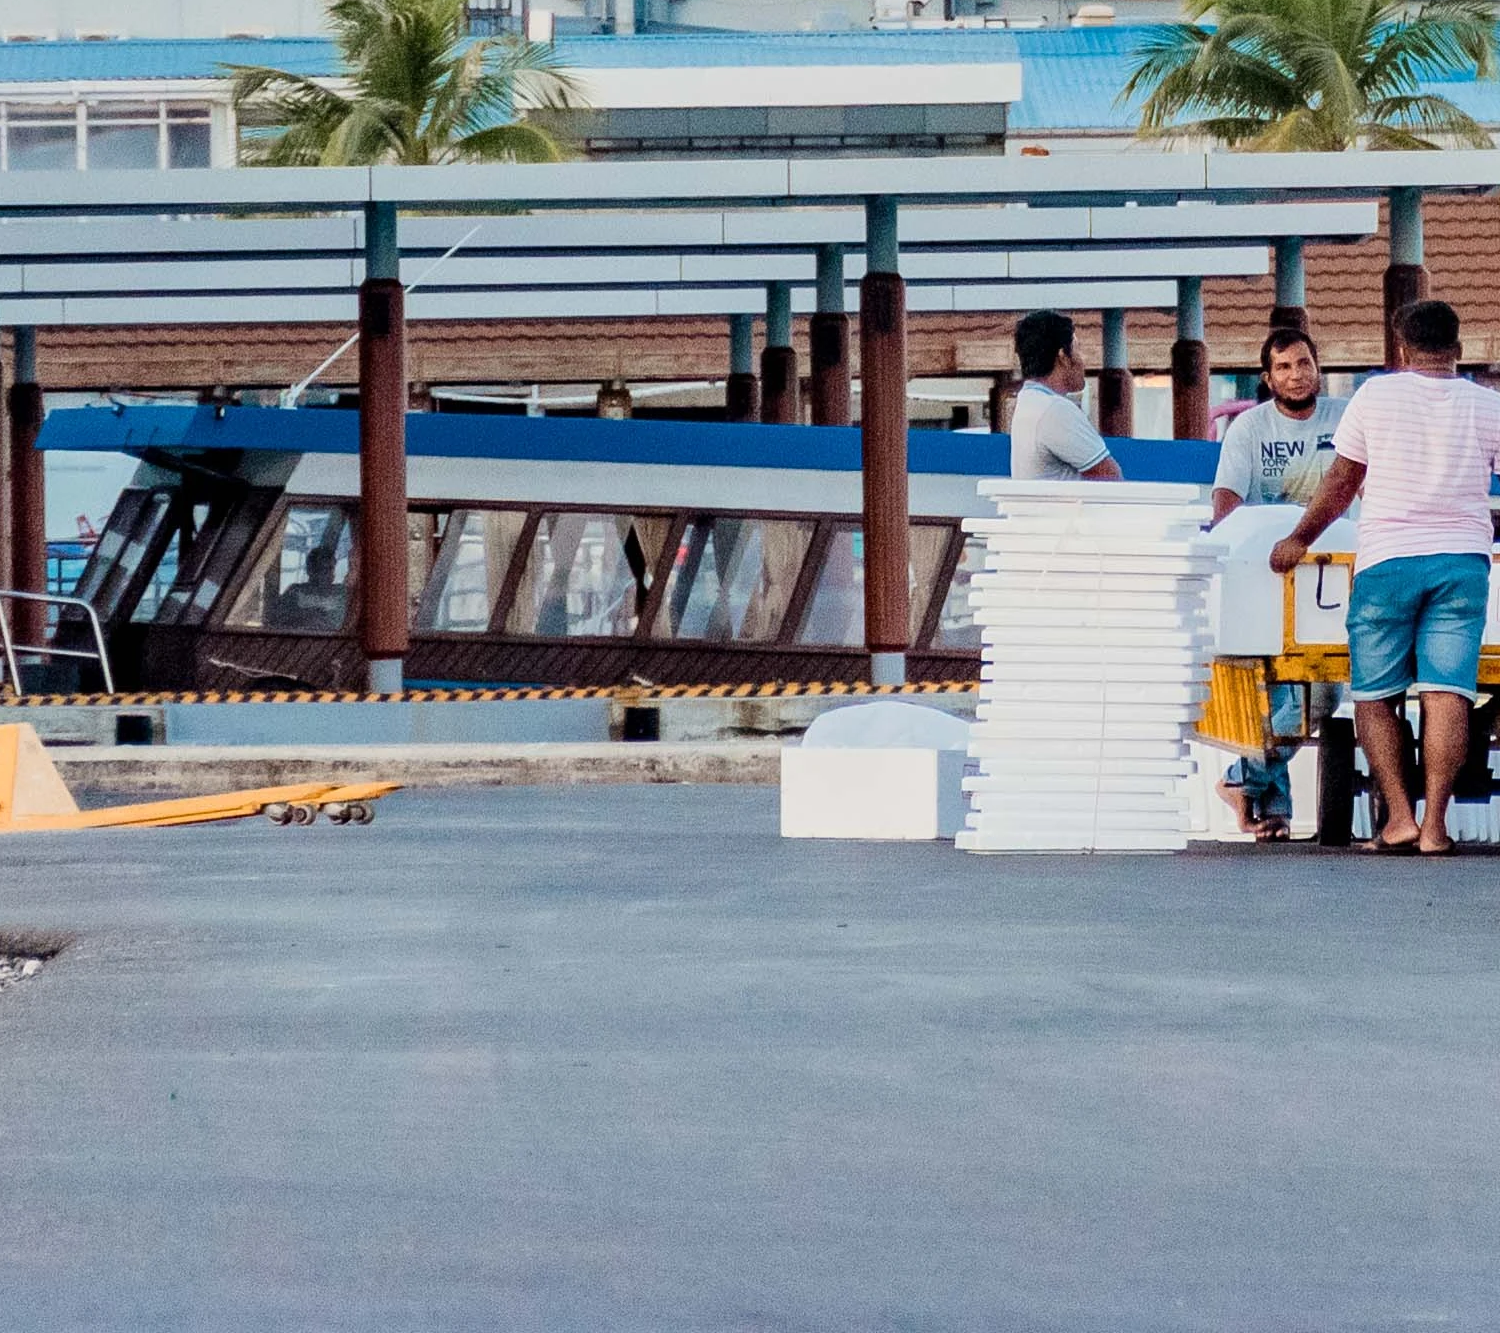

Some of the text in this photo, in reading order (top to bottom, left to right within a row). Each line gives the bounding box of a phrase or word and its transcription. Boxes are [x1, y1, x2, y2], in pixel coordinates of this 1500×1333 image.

[1260, 440, 1304, 458] NEW
[1261, 457, 1290, 468] YORK
[1262, 467, 1285, 477] CITY
